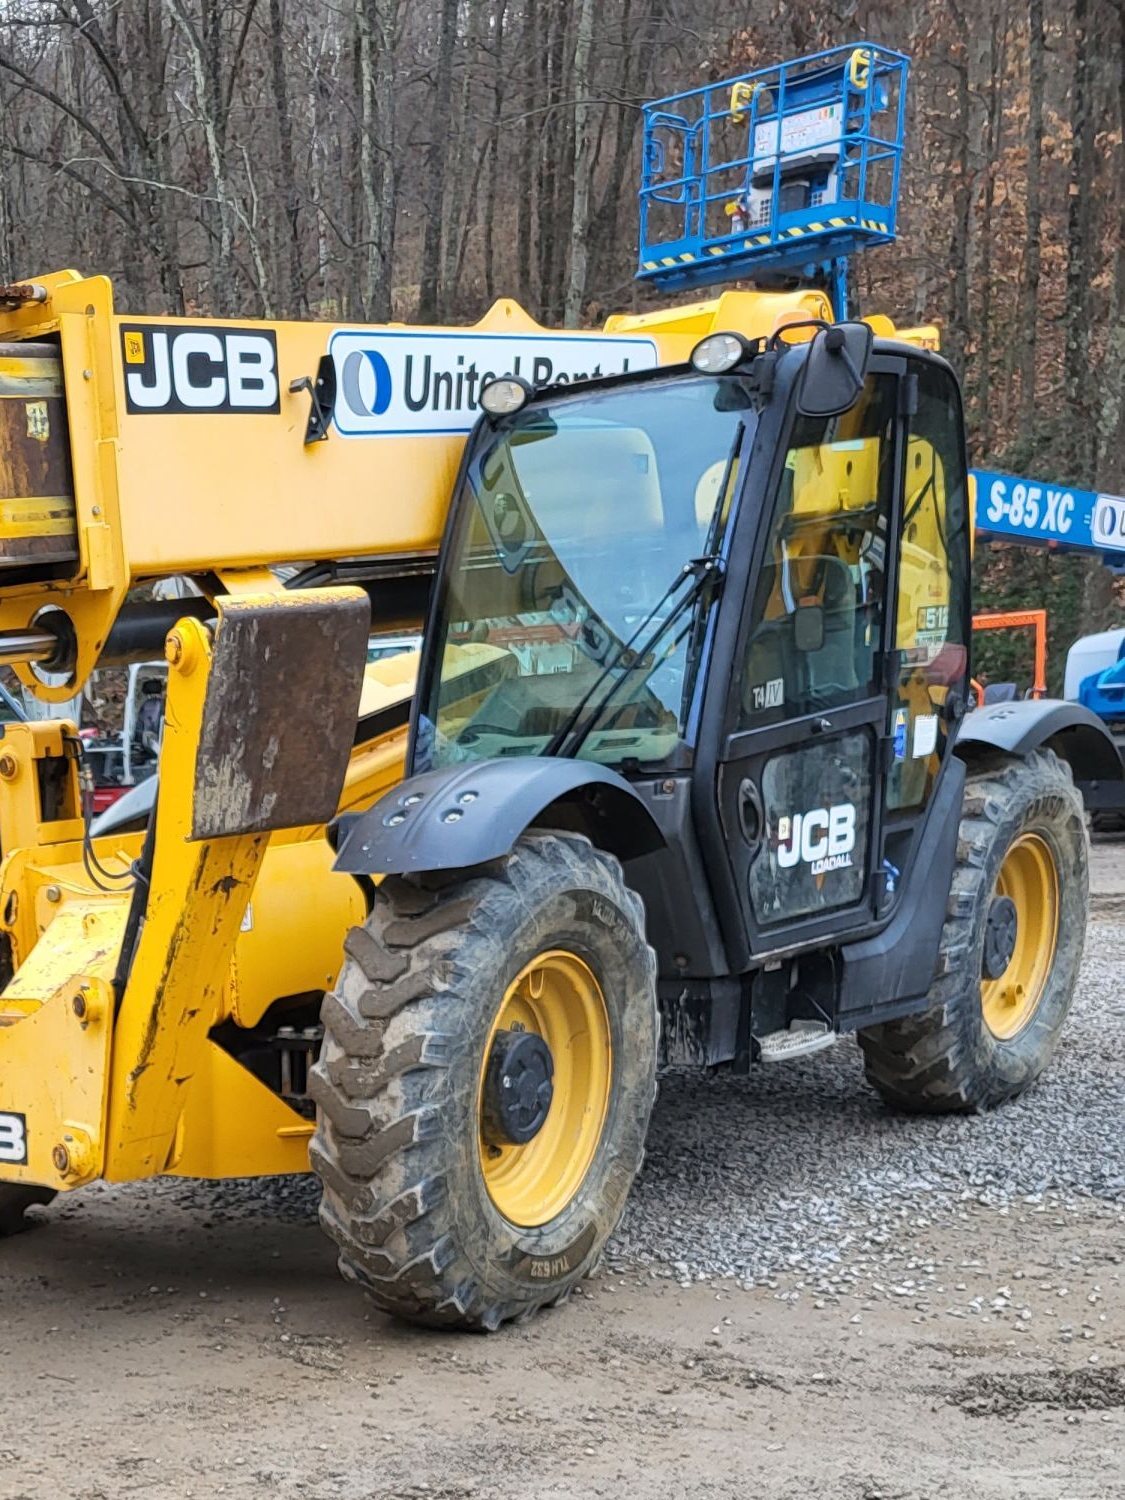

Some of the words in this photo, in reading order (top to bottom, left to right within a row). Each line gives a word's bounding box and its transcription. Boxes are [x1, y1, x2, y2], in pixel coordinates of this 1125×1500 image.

[126, 332, 278, 408] JCB
[986, 480, 1042, 529] S-85
[1040, 489, 1075, 534] XC
[777, 803, 856, 868] JCB
[810, 853, 854, 875] LOADALL
